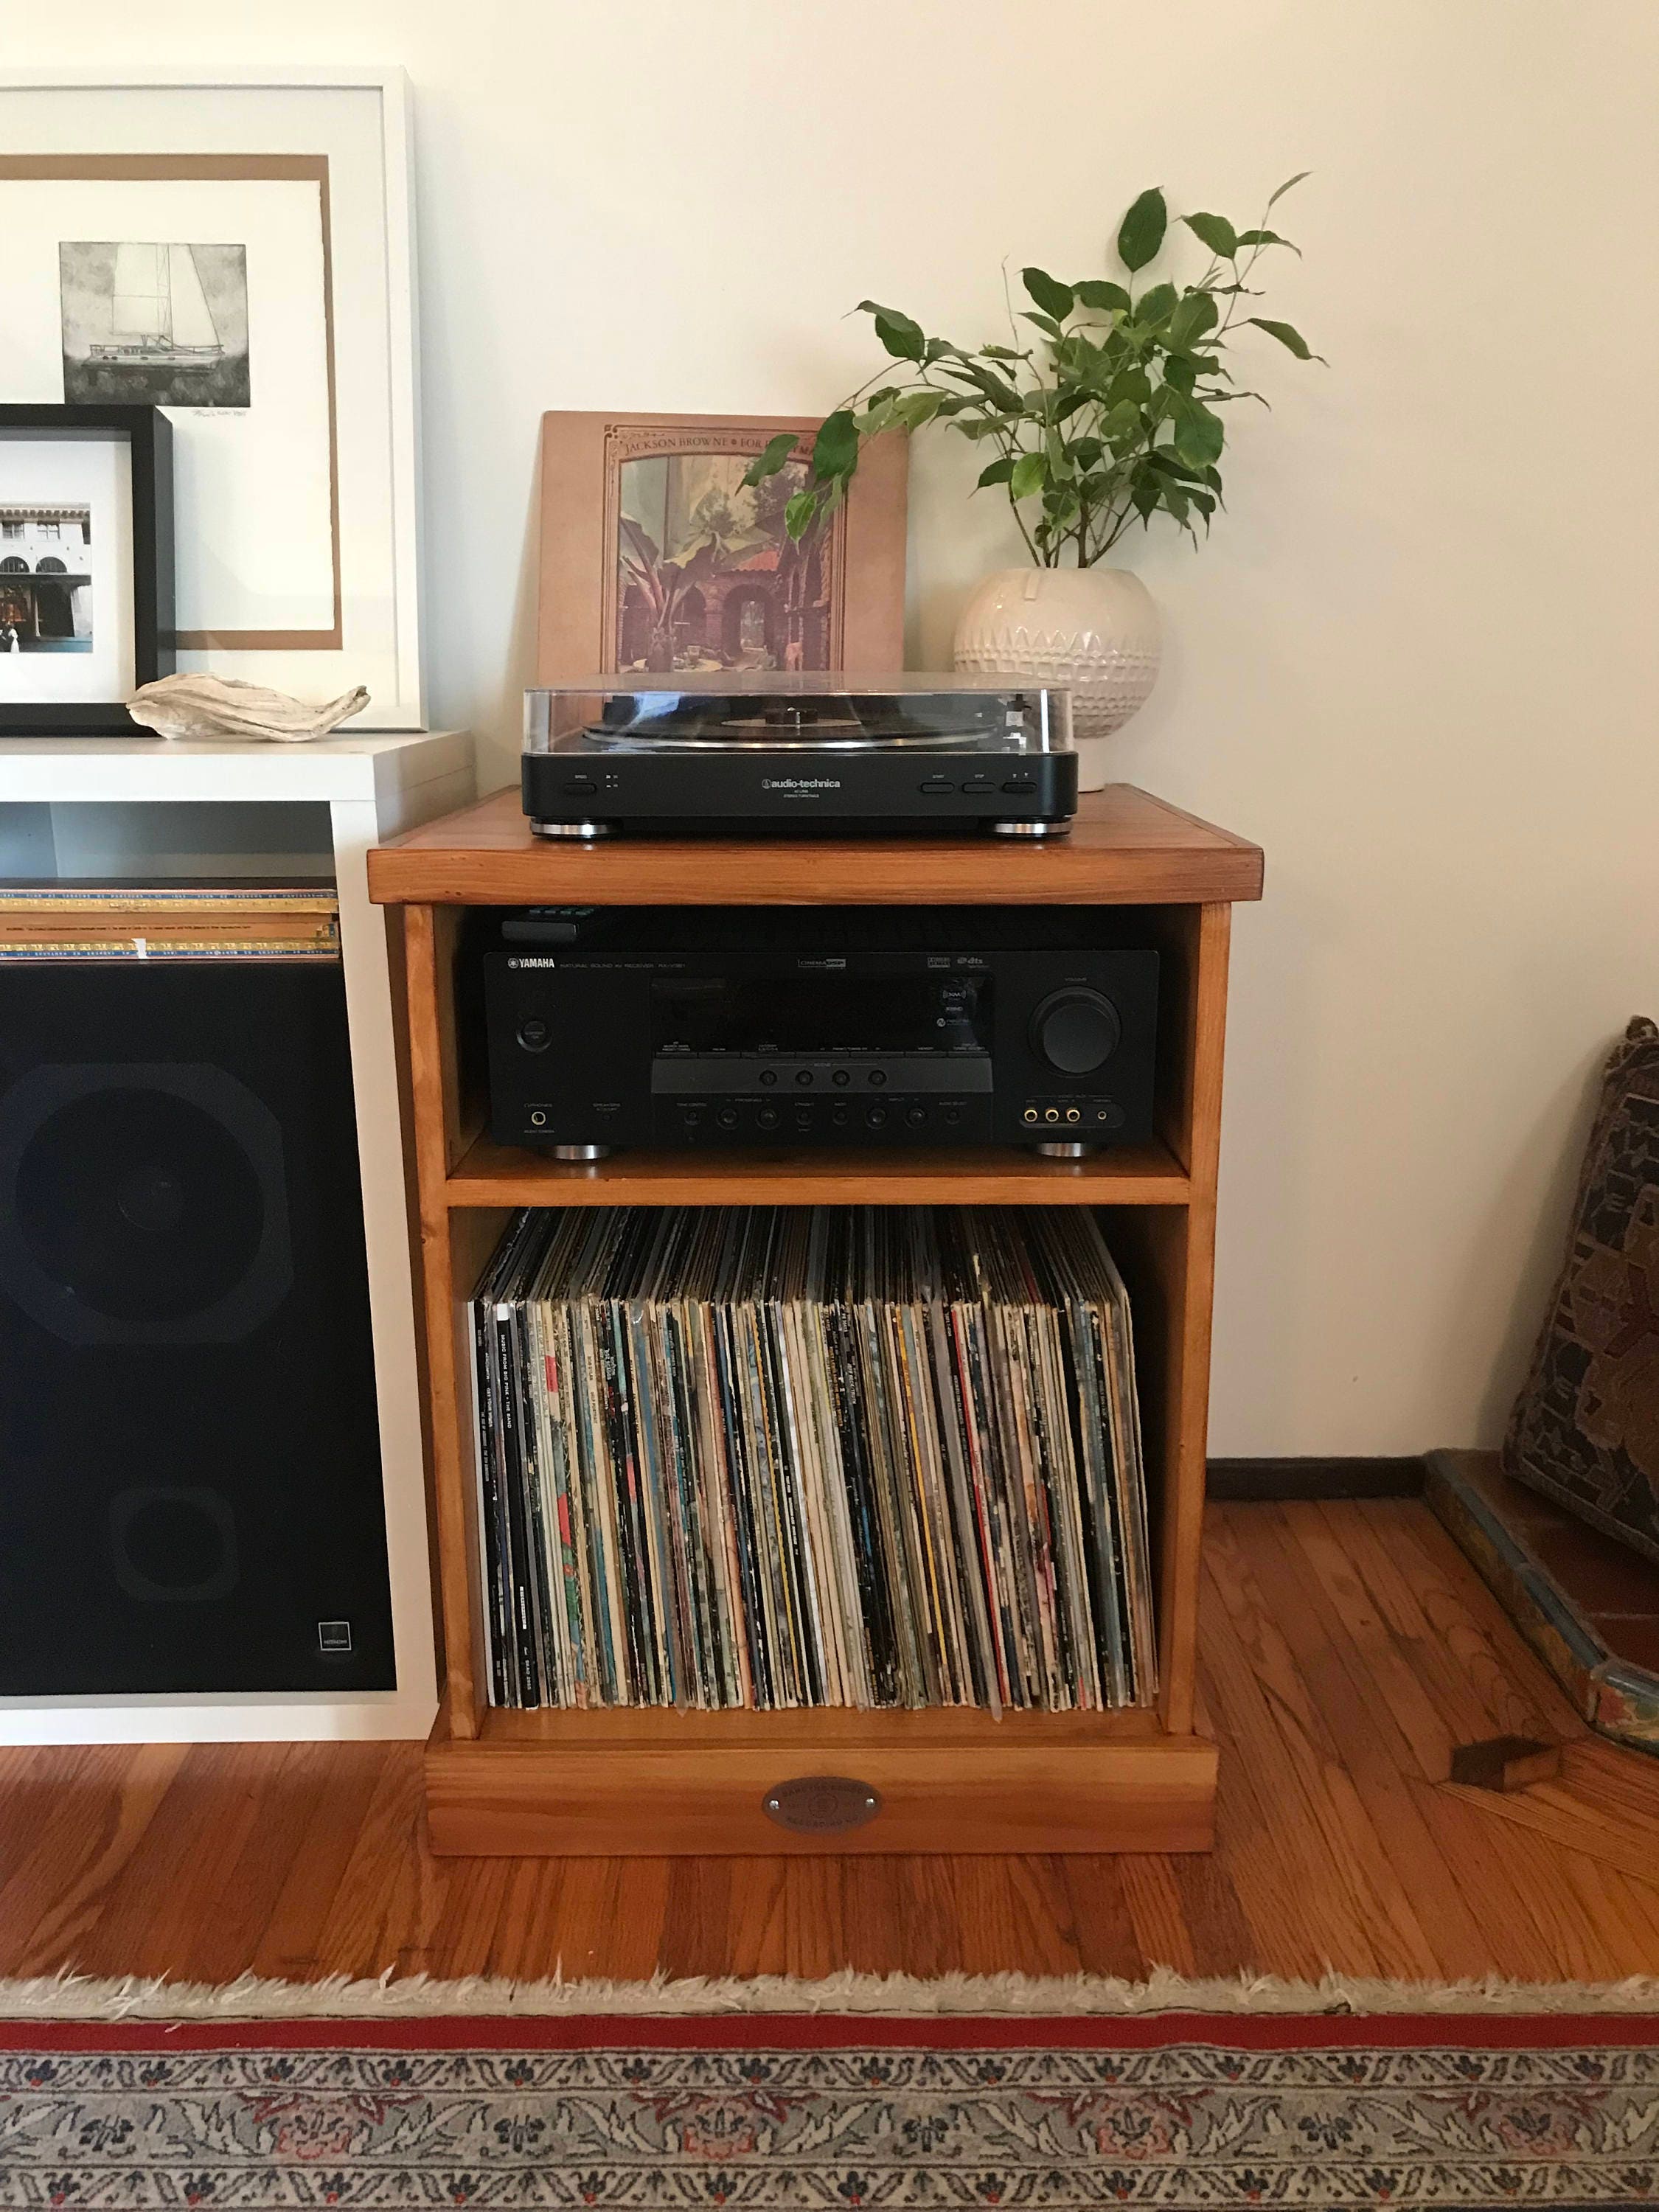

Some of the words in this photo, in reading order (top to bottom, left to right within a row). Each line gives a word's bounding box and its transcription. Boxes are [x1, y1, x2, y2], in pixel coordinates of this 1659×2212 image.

[625, 438, 676, 456] JACKSON
[679, 437, 726, 446] BROWNE
[771, 778, 841, 788] audio-technica
[518, 959, 554, 968] YAMAHA
